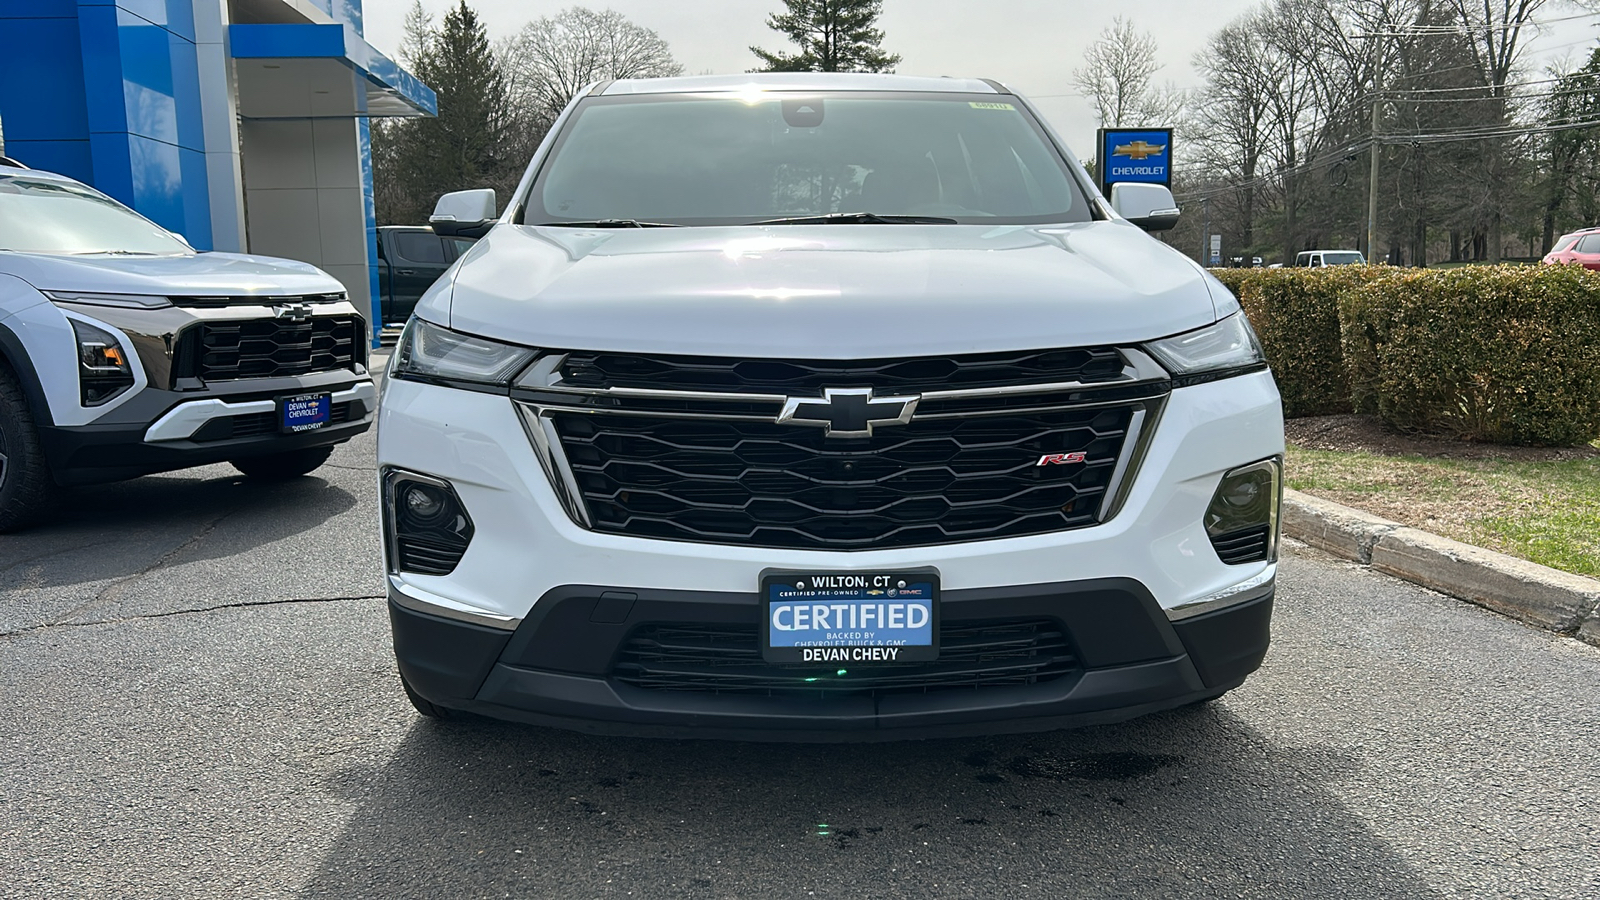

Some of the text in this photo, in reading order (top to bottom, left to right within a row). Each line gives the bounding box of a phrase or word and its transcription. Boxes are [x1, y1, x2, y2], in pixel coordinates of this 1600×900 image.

[1112, 166, 1165, 175] CHEVROLET
[289, 402, 307, 411] DEVAN
[289, 408, 318, 418] CHEVROLET
[1036, 451, 1087, 466] RS
[811, 576, 891, 588] WILTON, CT
[772, 603, 929, 631] CERTIFIED
[826, 632, 861, 640] BACKED
[803, 647, 898, 661] DEVAN CHEVY
